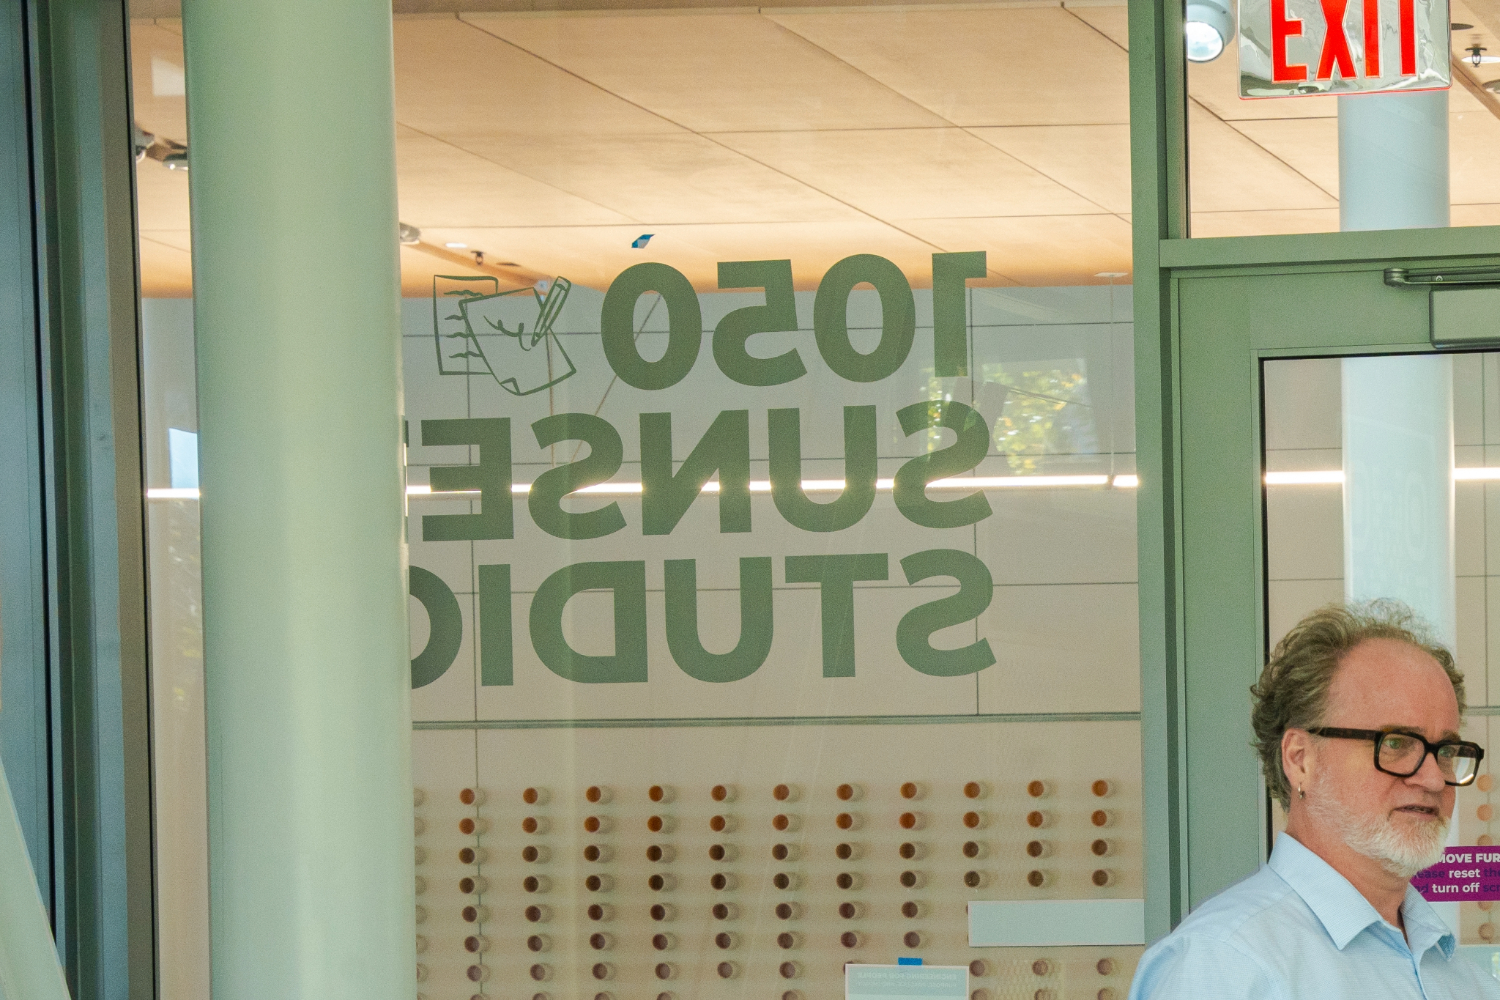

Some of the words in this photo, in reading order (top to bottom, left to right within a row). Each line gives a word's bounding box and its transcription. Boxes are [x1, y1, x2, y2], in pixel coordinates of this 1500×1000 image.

[1449, 868, 1481, 878] reset
[1432, 884, 1459, 893] turn
[1462, 882, 1480, 893] off
